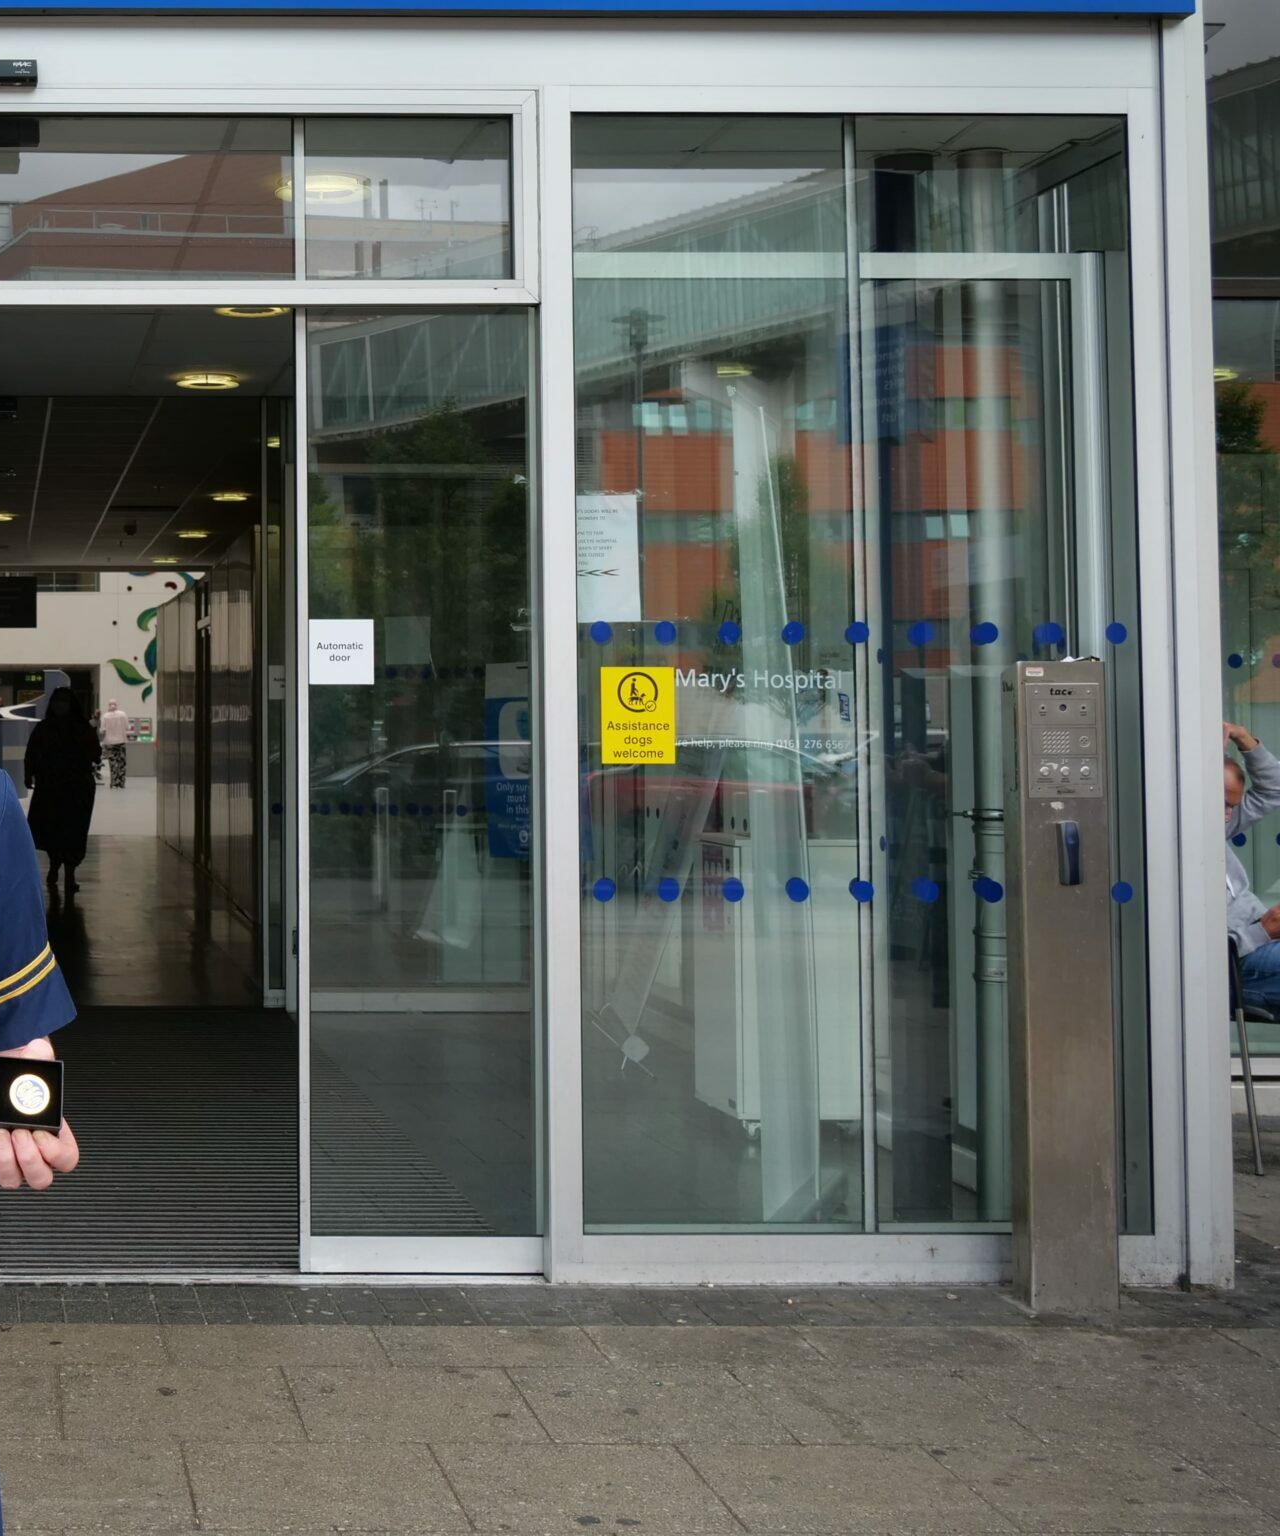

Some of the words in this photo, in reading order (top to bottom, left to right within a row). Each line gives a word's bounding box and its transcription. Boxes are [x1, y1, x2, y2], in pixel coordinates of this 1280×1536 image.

[316, 641, 364, 651] Automatic
[329, 653, 351, 662] door
[675, 667, 745, 692] Mary's
[754, 669, 842, 693] Hospital
[606, 720, 670, 732] Assistance
[623, 736, 653, 746] dogs
[719, 738, 751, 750] please
[804, 739, 823, 750] 276
[613, 749, 664, 759] welcome
